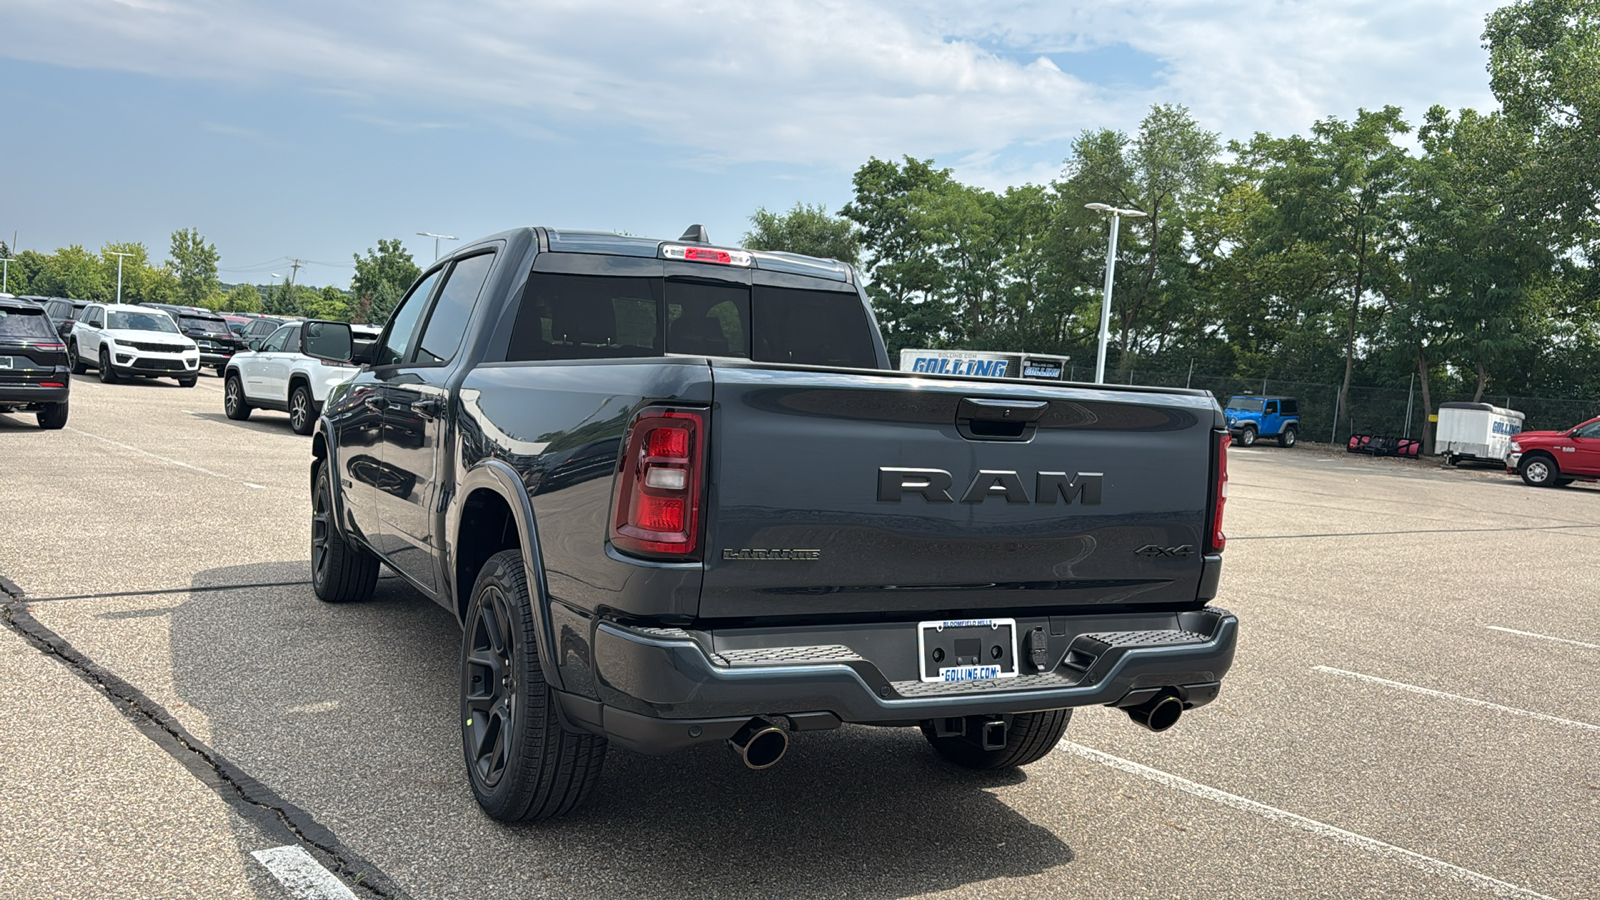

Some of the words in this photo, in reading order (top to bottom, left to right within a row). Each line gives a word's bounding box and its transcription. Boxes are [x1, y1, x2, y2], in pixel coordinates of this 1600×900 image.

[912, 357, 1008, 377] GOLLING
[1024, 366, 1060, 377] GOLLING
[1492, 421, 1520, 436] GOLLING
[876, 466, 1104, 505] RAM
[945, 667, 997, 681] GOLLING.COM
